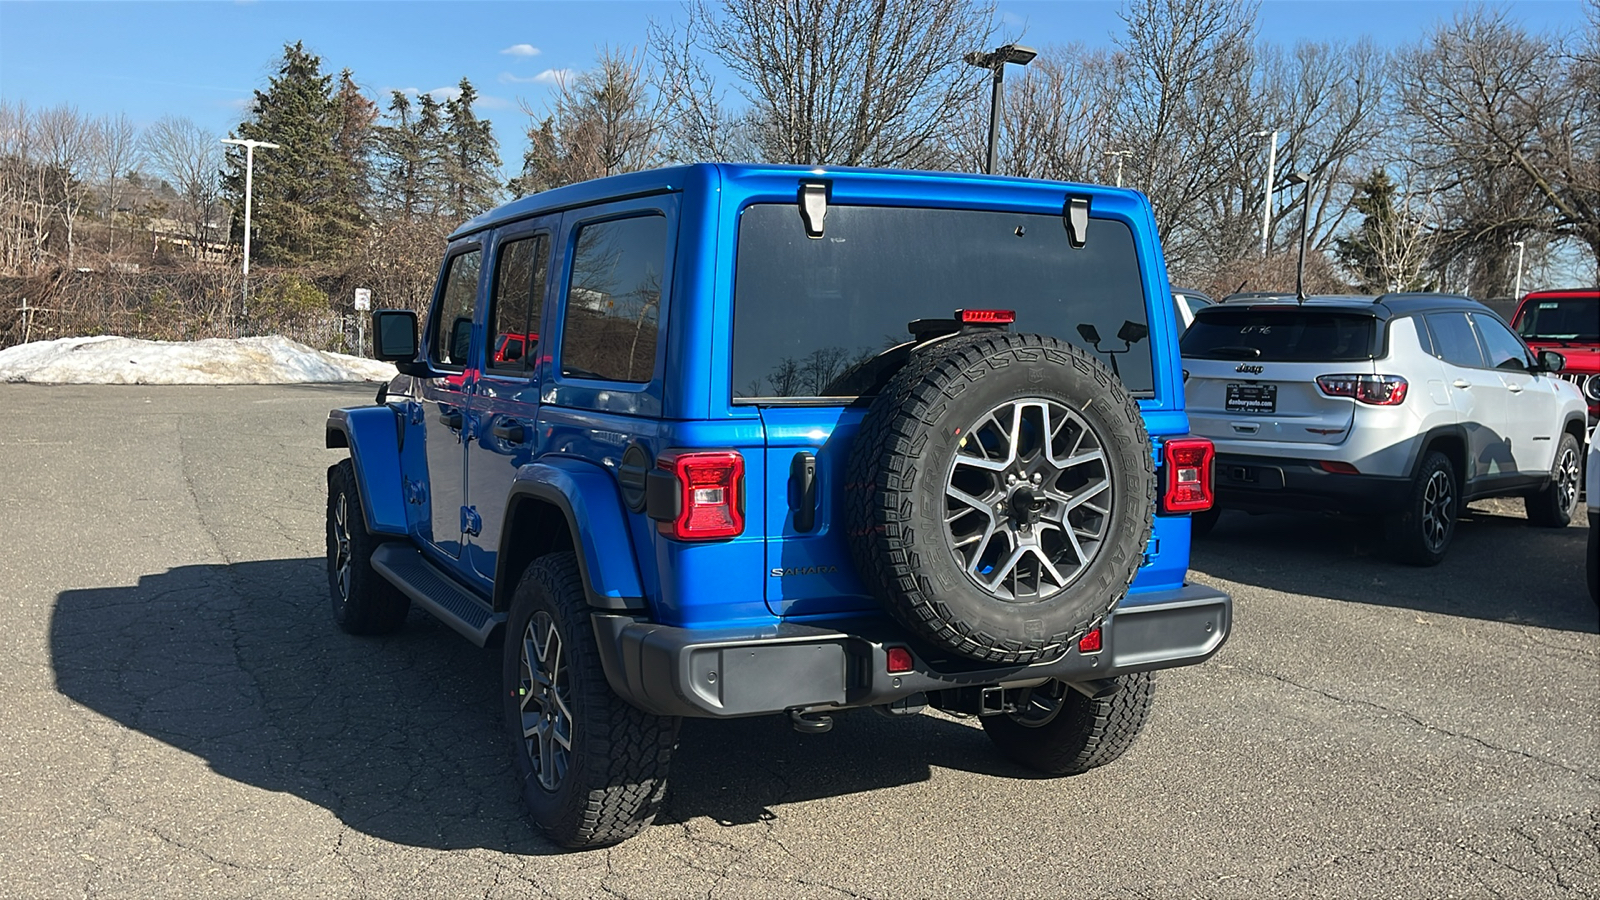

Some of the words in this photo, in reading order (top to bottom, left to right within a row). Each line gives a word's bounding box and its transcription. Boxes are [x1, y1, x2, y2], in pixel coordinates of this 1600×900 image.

[1235, 362, 1264, 375] Jeep
[1228, 399, 1273, 407] danburyauto.com
[1091, 397, 1141, 539] GRABBER
[920, 426, 958, 592] GENERAL
[770, 565, 838, 578] SAHARA
